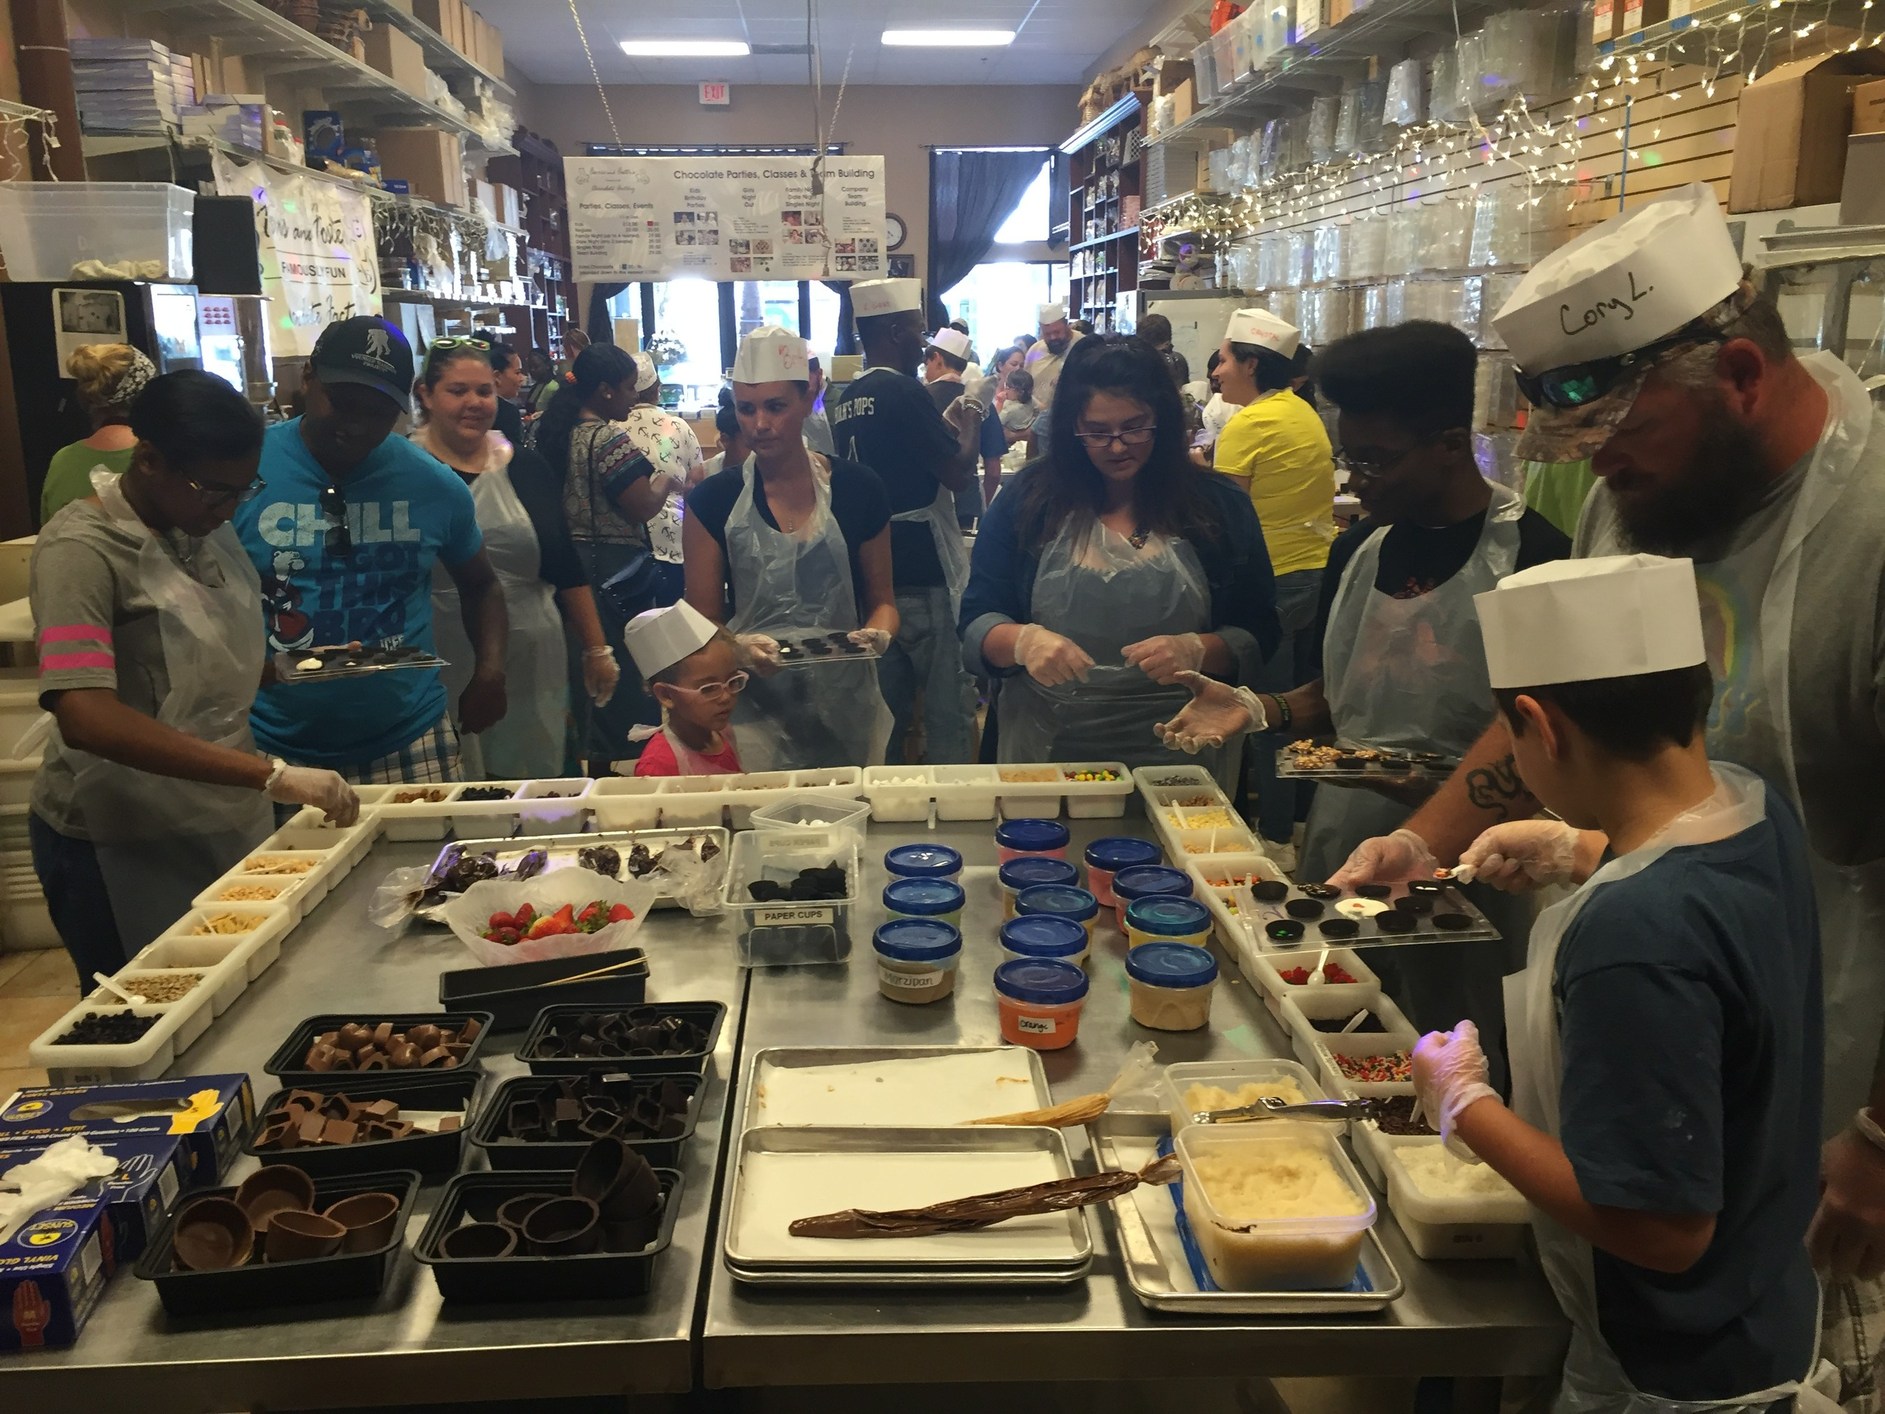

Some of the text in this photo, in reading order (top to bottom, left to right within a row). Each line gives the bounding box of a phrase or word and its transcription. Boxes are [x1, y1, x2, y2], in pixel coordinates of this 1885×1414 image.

[704, 84, 725, 99] EXIT
[673, 170, 724, 179] Chocolate
[727, 170, 760, 179] Parties,
[763, 169, 798, 179] Classes
[801, 169, 807, 178] &
[838, 168, 875, 179] Building
[325, 266, 347, 279] FUN
[1560, 271, 1654, 336] Cory L.
[853, 396, 875, 417] POPS
[258, 500, 421, 547] CHILL
[347, 541, 422, 574] GOT
[314, 570, 420, 609] THIS
[313, 600, 407, 645] BRO
[765, 910, 823, 920] PAPER CUPS
[121, 1173, 130, 1181] L
[28, 1220, 75, 1231] SUNSET
[24, 1253, 59, 1264] VINYL
